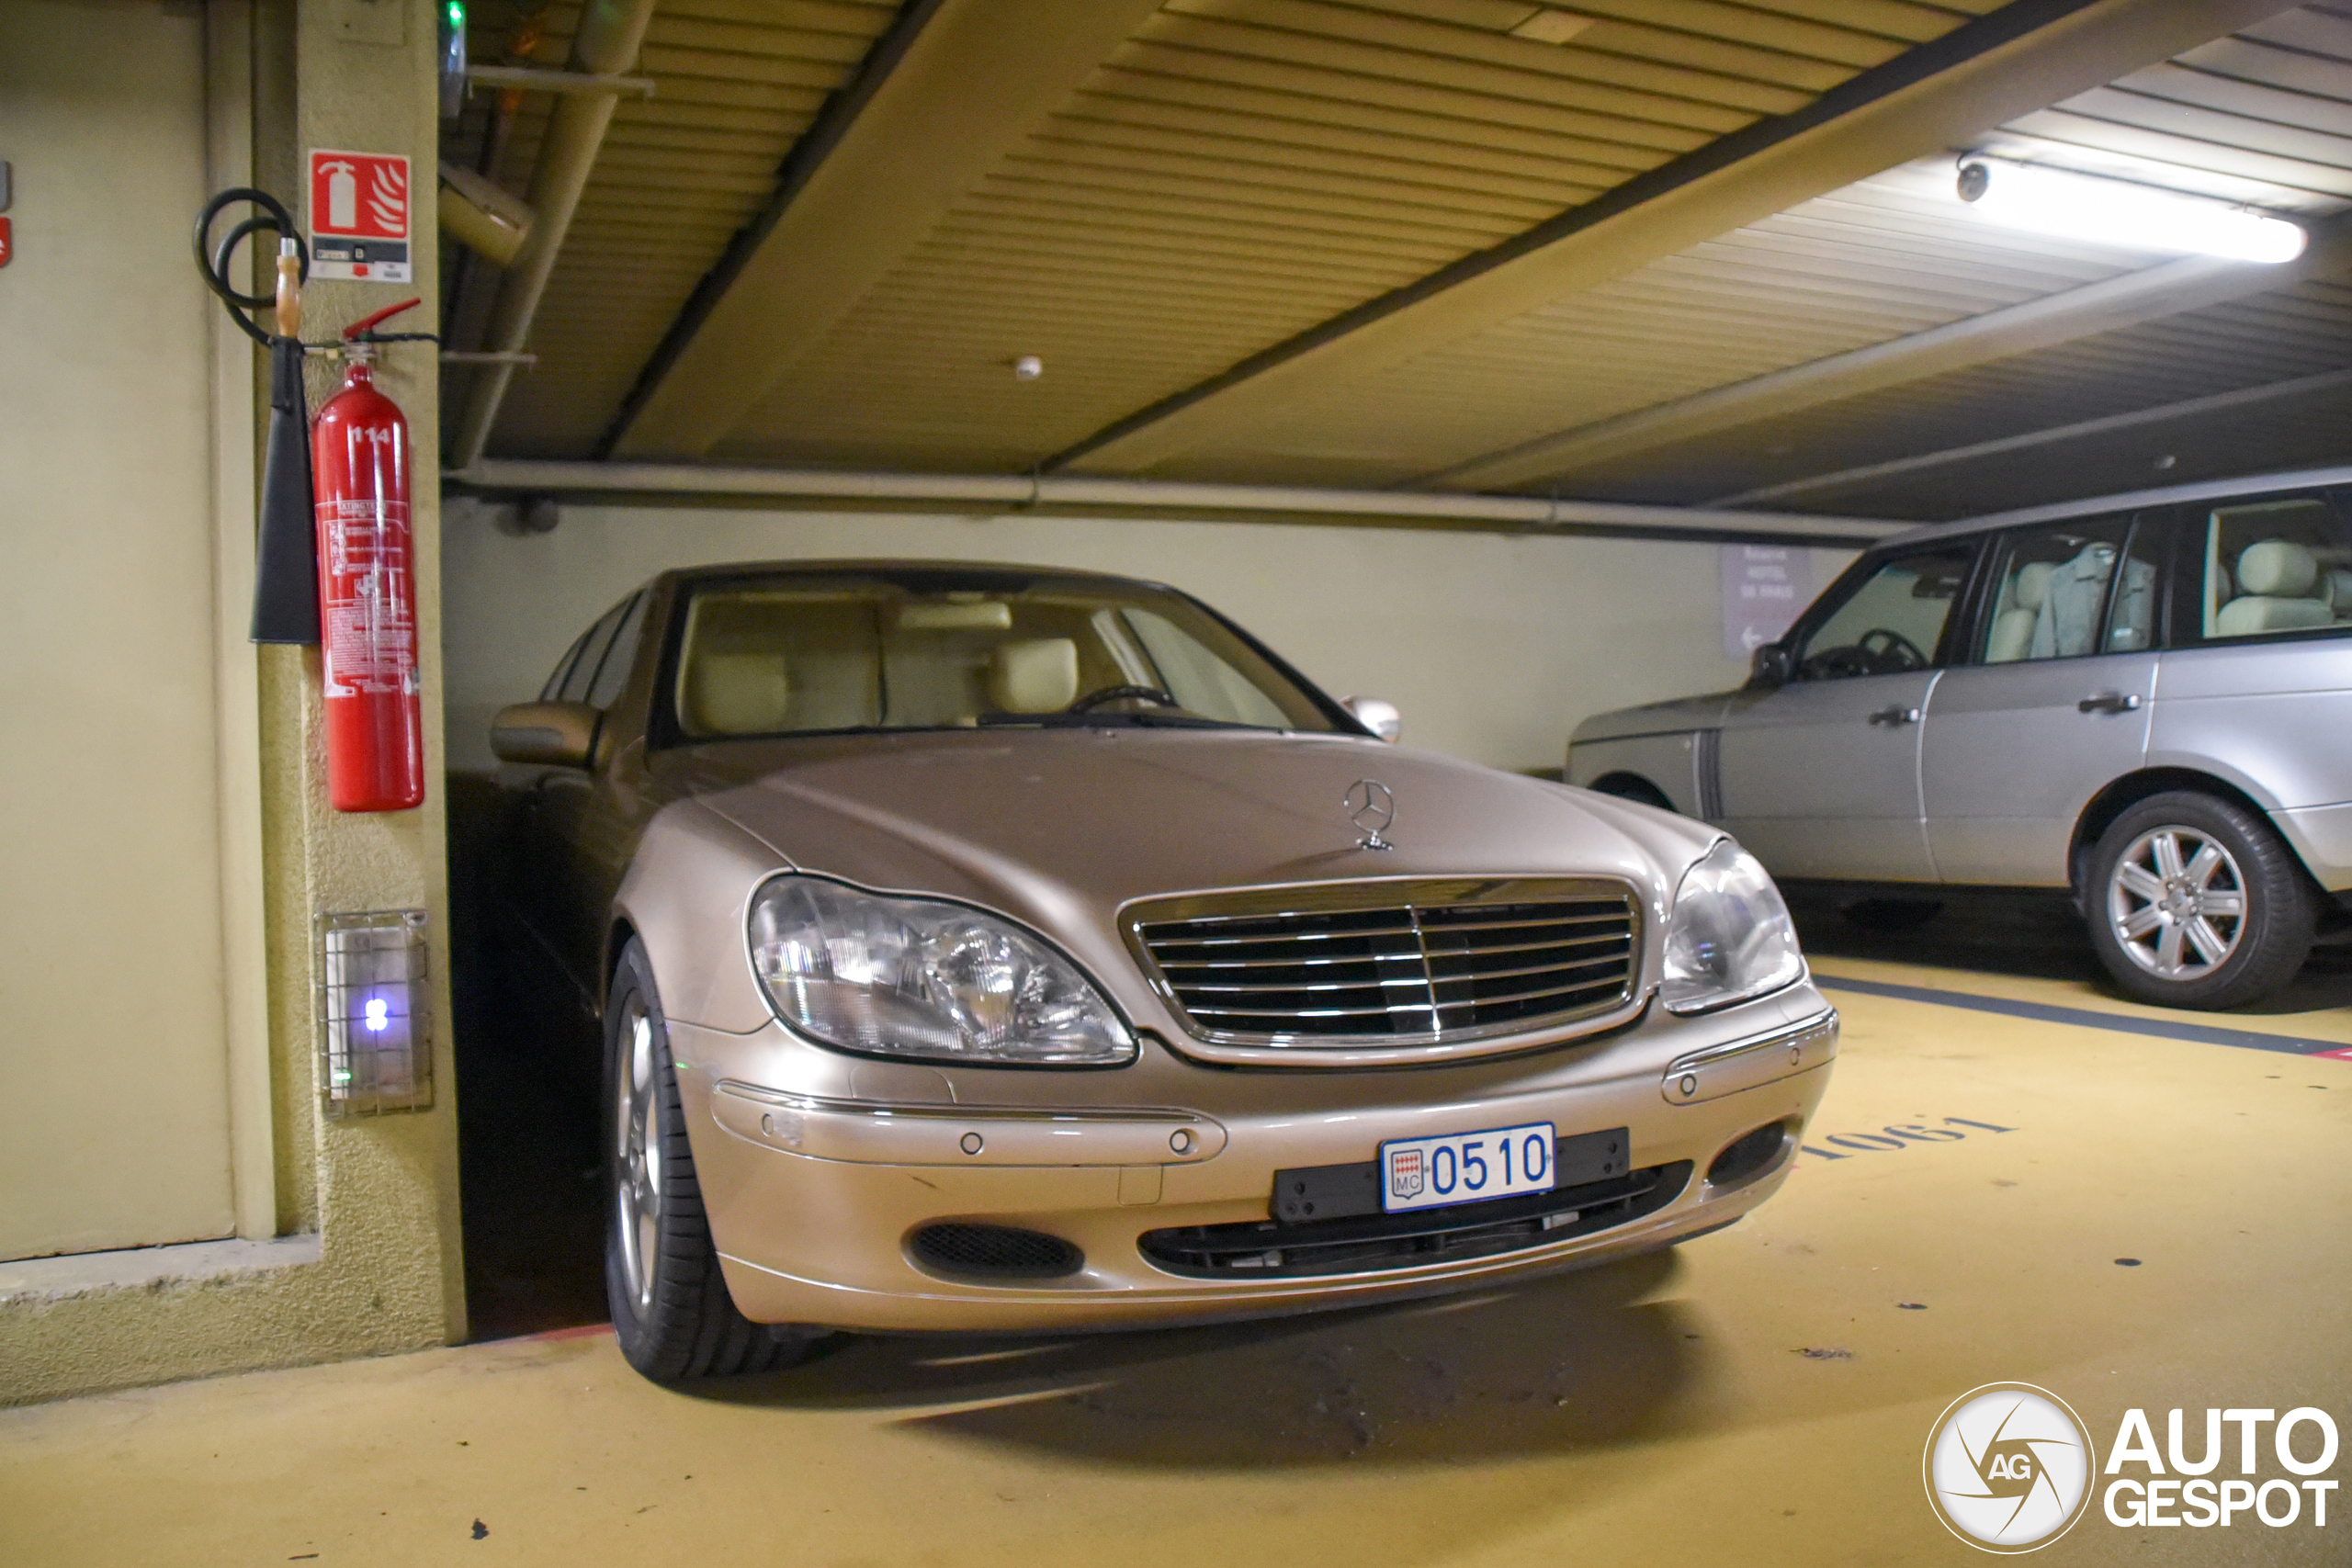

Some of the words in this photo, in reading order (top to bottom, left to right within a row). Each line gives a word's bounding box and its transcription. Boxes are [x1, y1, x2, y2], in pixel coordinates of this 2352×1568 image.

[352, 425, 390, 444] 114
[1801, 1116, 2019, 1161] 1061
[1396, 1175, 1420, 1192] MC
[1431, 1133, 1547, 1195] 0510
